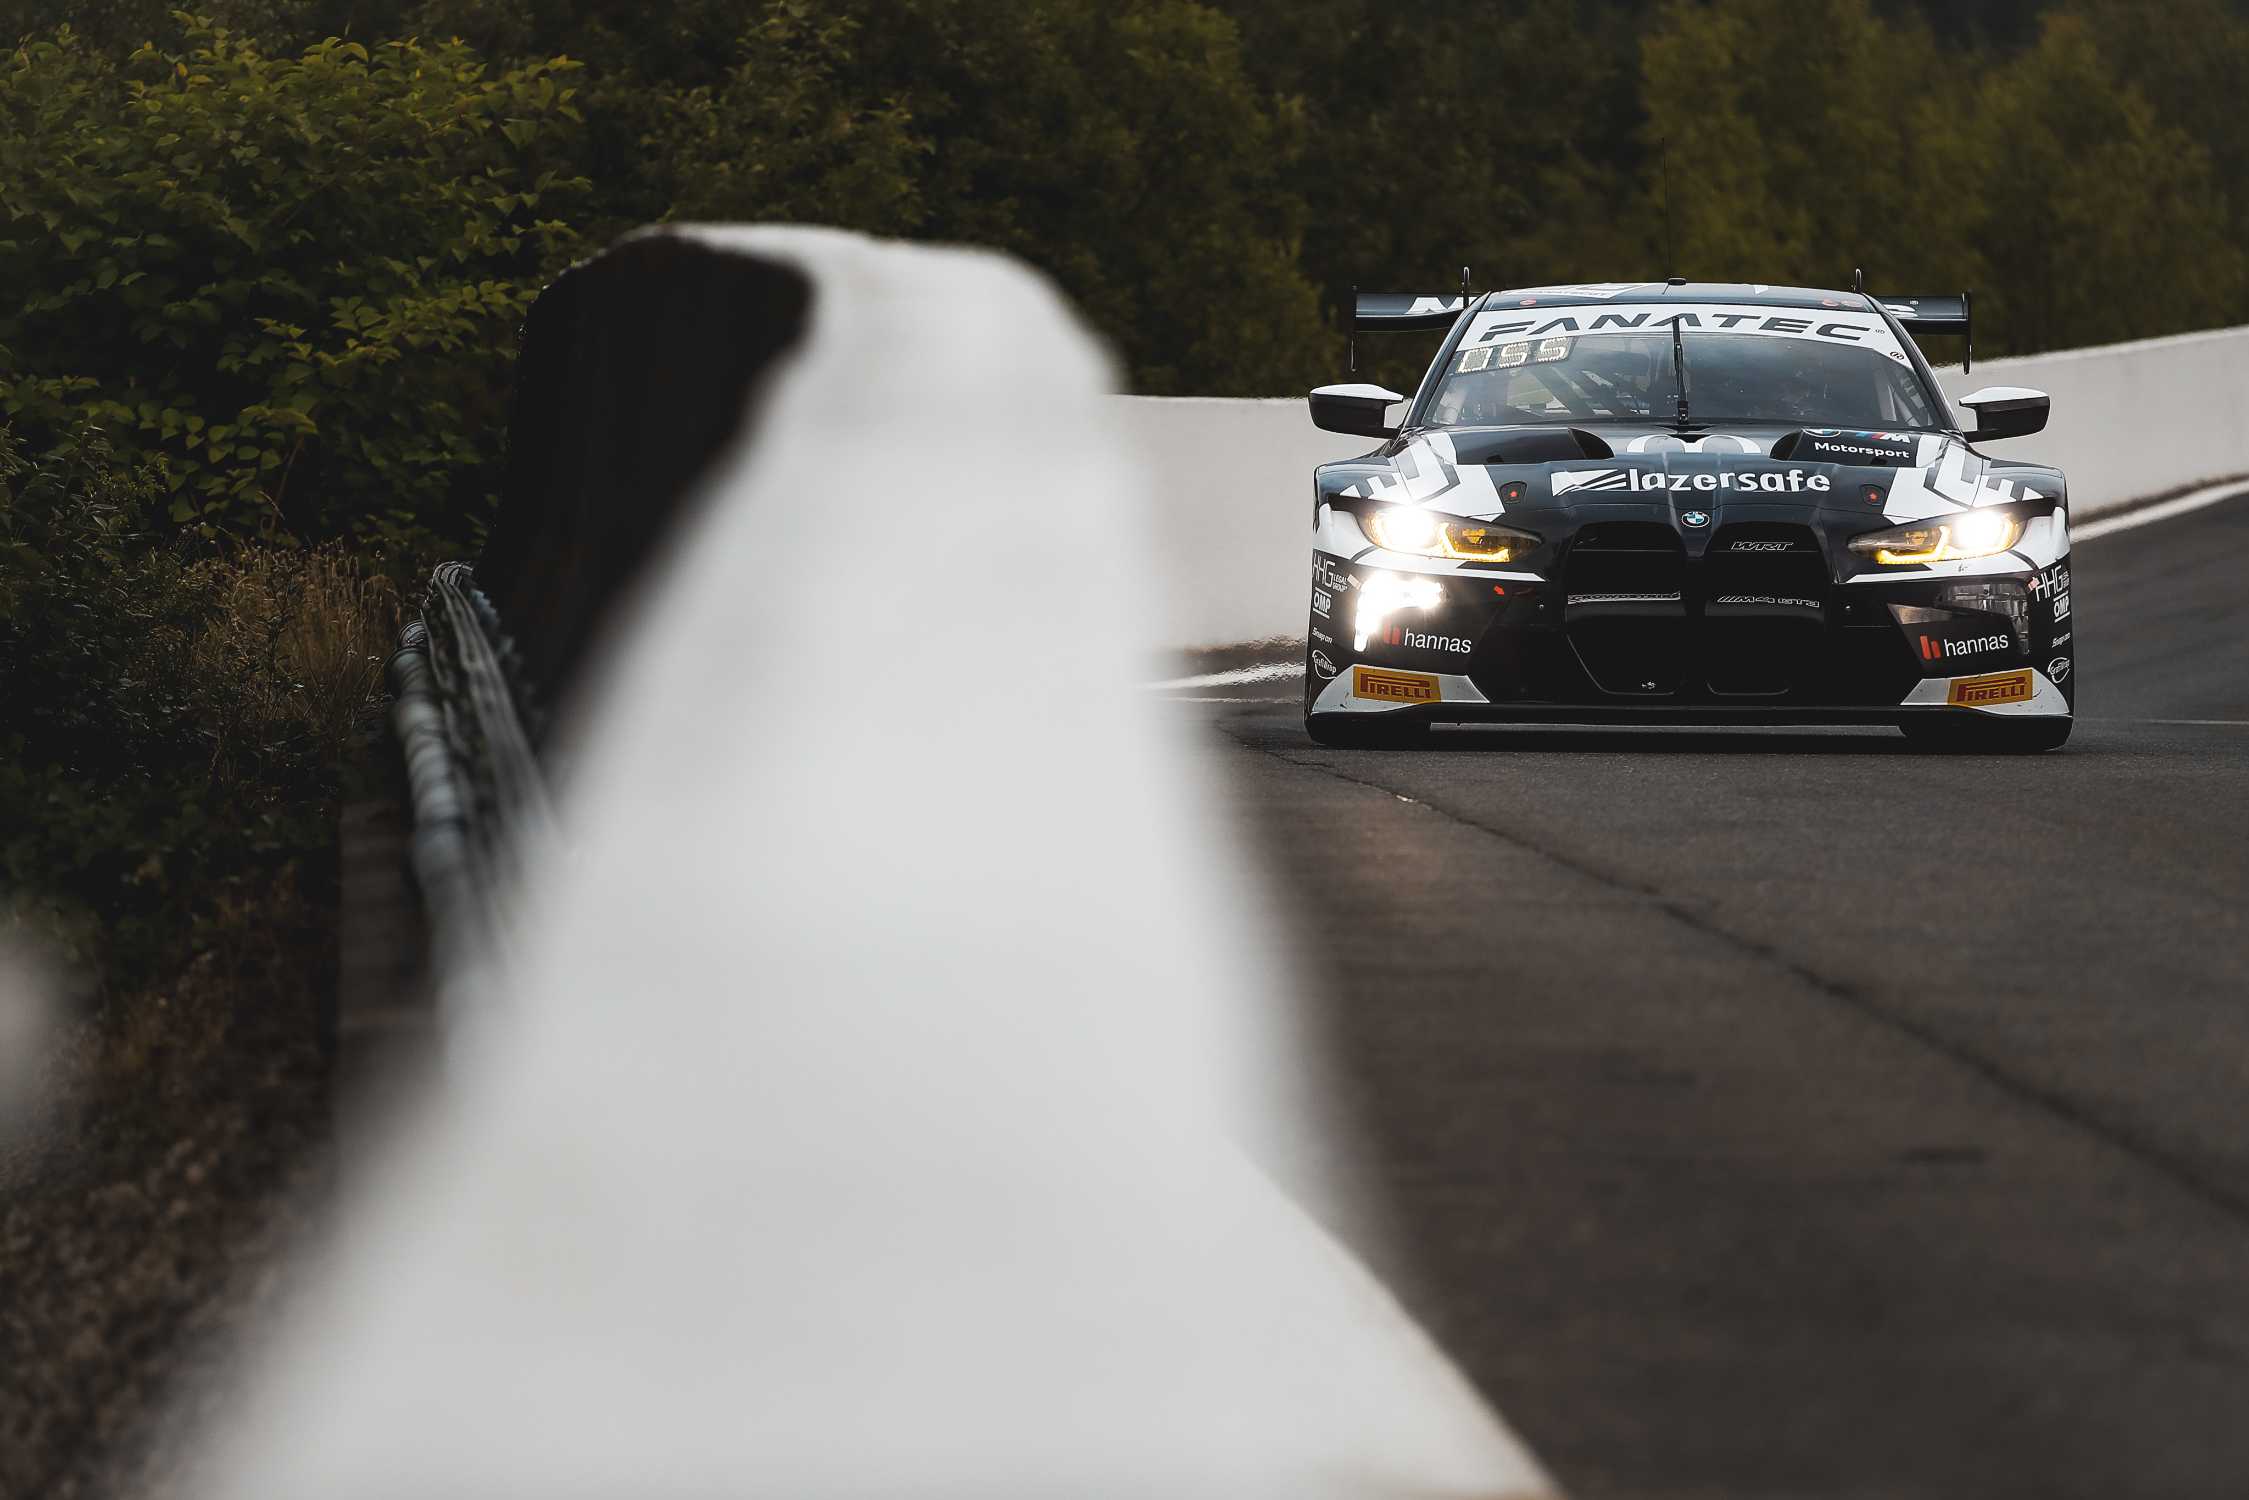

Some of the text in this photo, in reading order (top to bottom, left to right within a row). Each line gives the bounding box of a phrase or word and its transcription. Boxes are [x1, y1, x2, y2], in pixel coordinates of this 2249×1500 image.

[1478, 312, 1870, 342] FANATEC
[1814, 442, 1910, 458] Motorsport
[1629, 468, 1831, 492] lazersafe
[1731, 541, 1794, 551] WRT
[1312, 551, 1336, 588] HHG
[2036, 565, 2062, 602] HHG
[1313, 591, 1331, 613] OMP
[2054, 595, 2070, 618] OMP
[1404, 628, 1472, 653] hannas
[1944, 634, 2009, 657] hannas
[1360, 673, 1431, 698] PIRELLI
[1956, 676, 2026, 702] PIRELLI
